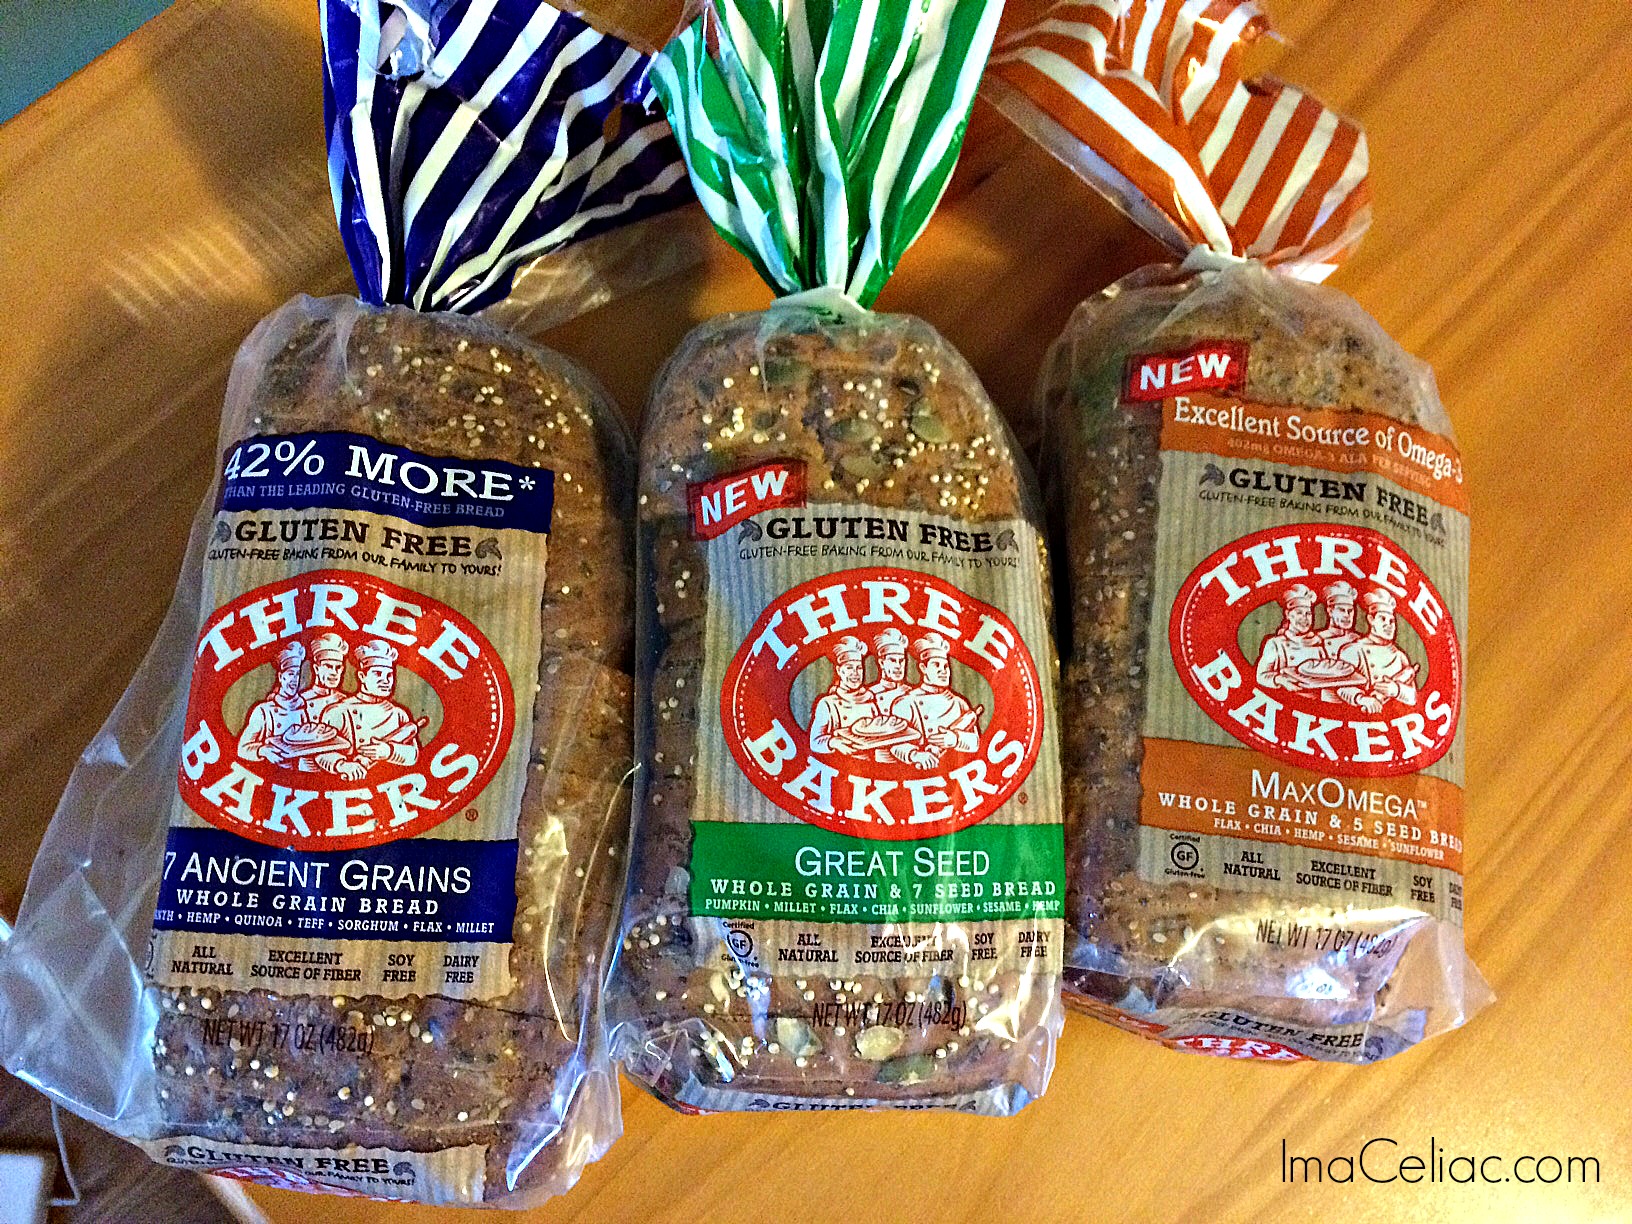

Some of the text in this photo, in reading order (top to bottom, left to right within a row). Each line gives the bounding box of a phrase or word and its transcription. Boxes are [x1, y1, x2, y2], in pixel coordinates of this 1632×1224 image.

[1139, 353, 1231, 390] NEW
[1174, 396, 1463, 485] Excellent Source of Omega-3
[224, 439, 325, 481] 42%
[259, 484, 285, 497] THE
[288, 483, 346, 496] LEADING
[350, 485, 451, 514] GLUTEN-FREE
[455, 503, 505, 518] BREAD
[700, 470, 789, 526] NEW
[1199, 490, 1275, 508] GLUTEN-FREE
[1279, 499, 1322, 513] BAKING
[1325, 504, 1359, 518] FROM
[1229, 468, 1428, 527] GLUTEN FREE
[235, 518, 472, 557] GLUTEN FREE
[766, 517, 994, 552] GLUTEN FREE
[283, 547, 319, 561] BAKING
[321, 548, 358, 560] FROM
[362, 551, 388, 567] OUR
[390, 557, 437, 573] FAMILY
[441, 562, 457, 574] TO
[461, 563, 503, 577] YOURS!
[739, 545, 818, 560] GLUTEN-FREE
[821, 545, 866, 557] BAKING
[870, 546, 904, 558] FROM
[907, 550, 930, 562] OUR
[931, 551, 964, 567] FAMILY
[968, 558, 982, 569] TO
[1201, 535, 1444, 635] THREE
[197, 583, 481, 680] THREE
[753, 580, 1015, 671] THREE
[1191, 649, 1452, 763] BAKERS
[181, 719, 480, 837] BAKERS
[745, 719, 1026, 825] BAKERS
[1158, 792, 1236, 815] WHOLE
[1248, 803, 1318, 826] GRAIN
[1329, 813, 1342, 829] &
[1353, 817, 1363, 832] 5
[1374, 820, 1422, 842] SEED
[1213, 817, 1445, 861] FLAX CHIA HEMP SESAME SUNFLOWER
[795, 846, 990, 878] GREAT SEED
[1176, 850, 1193, 861] GF
[1241, 851, 1264, 864] ALL
[163, 851, 471, 894] 7 ANCIENT GRAINS
[1223, 863, 1281, 881] NATURAL
[1310, 860, 1376, 880] EXCELLENT
[1413, 875, 1433, 889] SOY
[710, 879, 1056, 899] WHOLE GRAIN & 7 SEED BREAD
[1296, 872, 1393, 897] SOURCE OF FIBER
[1410, 889, 1436, 903] FREE
[176, 888, 439, 915] WHOLE GRAIN BREAD
[705, 898, 1061, 915] PUMPKIN MILLET FLAX CHIA SUNFLOWER SESAME HEMP
[186, 911, 221, 924] HEMP
[234, 914, 283, 927] QUINOA
[297, 917, 325, 930] TEFF
[337, 919, 399, 932] SORGHUM
[413, 921, 443, 933] FLAX
[455, 922, 495, 934] MILLET
[1288, 922, 1312, 949] WT
[1315, 927, 1330, 950] 17
[192, 945, 216, 959] ALL
[731, 938, 747, 950] GF
[796, 933, 821, 947] ALL
[974, 932, 995, 945] SOY
[171, 960, 234, 976] NATURAL
[268, 949, 343, 965] EXCELLENT
[387, 954, 416, 967] SOY
[443, 954, 480, 968] DAIRY
[778, 948, 839, 963] NATURAL
[854, 950, 902, 963] SOURCE
[922, 949, 954, 963] FIBER
[971, 948, 998, 961] FREE
[250, 964, 362, 982] SOURCE OF FIBER
[382, 969, 417, 982] FREE
[445, 971, 475, 984] FREE
[812, 1002, 842, 1028] NET
[875, 1002, 891, 1026] 17
[895, 1001, 916, 1026] OZ
[918, 1000, 967, 1031] (482g)
[1201, 1010, 1303, 1037] GLUTEN
[1306, 1033, 1364, 1048] FREE
[203, 1018, 239, 1046] NET
[240, 1020, 266, 1049] WT
[272, 1023, 290, 1049] 17
[294, 1023, 315, 1050] OZ
[188, 1145, 304, 1169] GLUTEN
[316, 1157, 390, 1174] FREE
